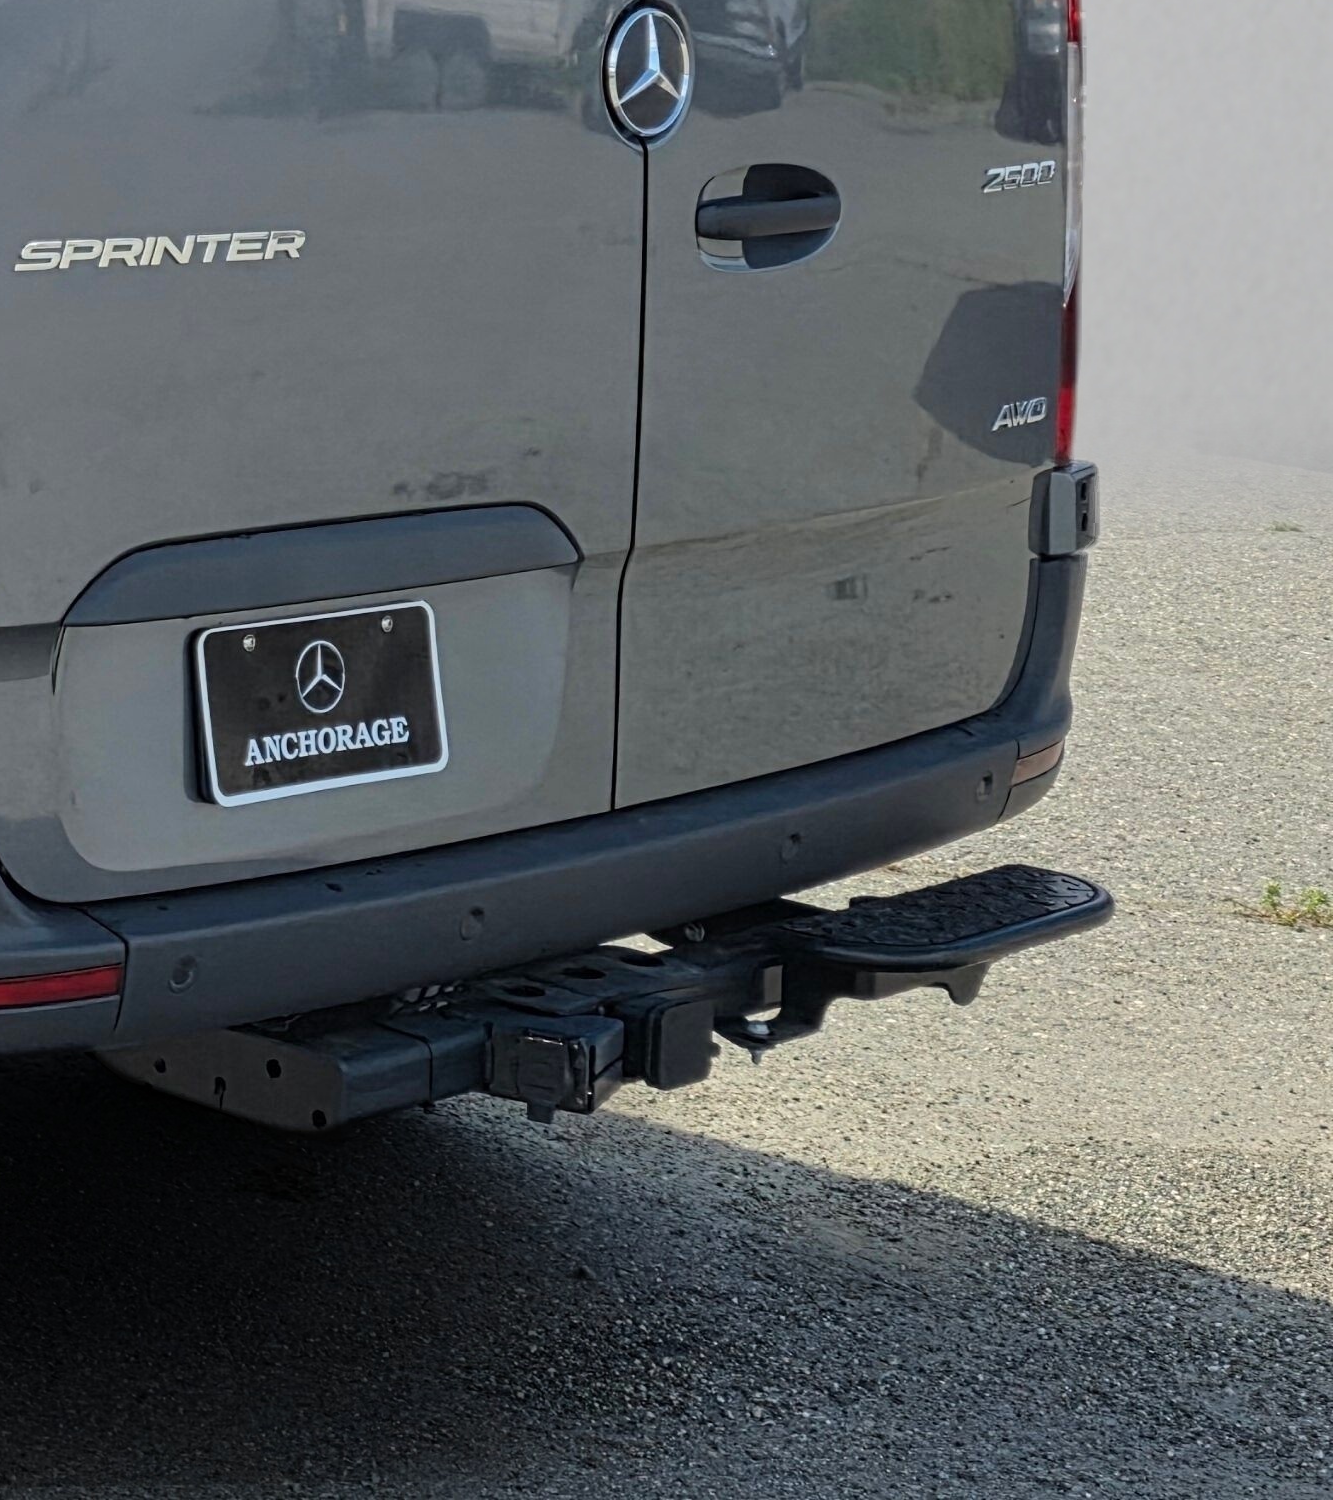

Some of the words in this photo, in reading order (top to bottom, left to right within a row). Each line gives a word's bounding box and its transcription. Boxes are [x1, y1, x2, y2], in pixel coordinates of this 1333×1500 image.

[983, 160, 1056, 193] 2500
[14, 230, 306, 272] SPRINTER
[991, 397, 1047, 431] AWD
[244, 716, 410, 766] ANCHORAGE
